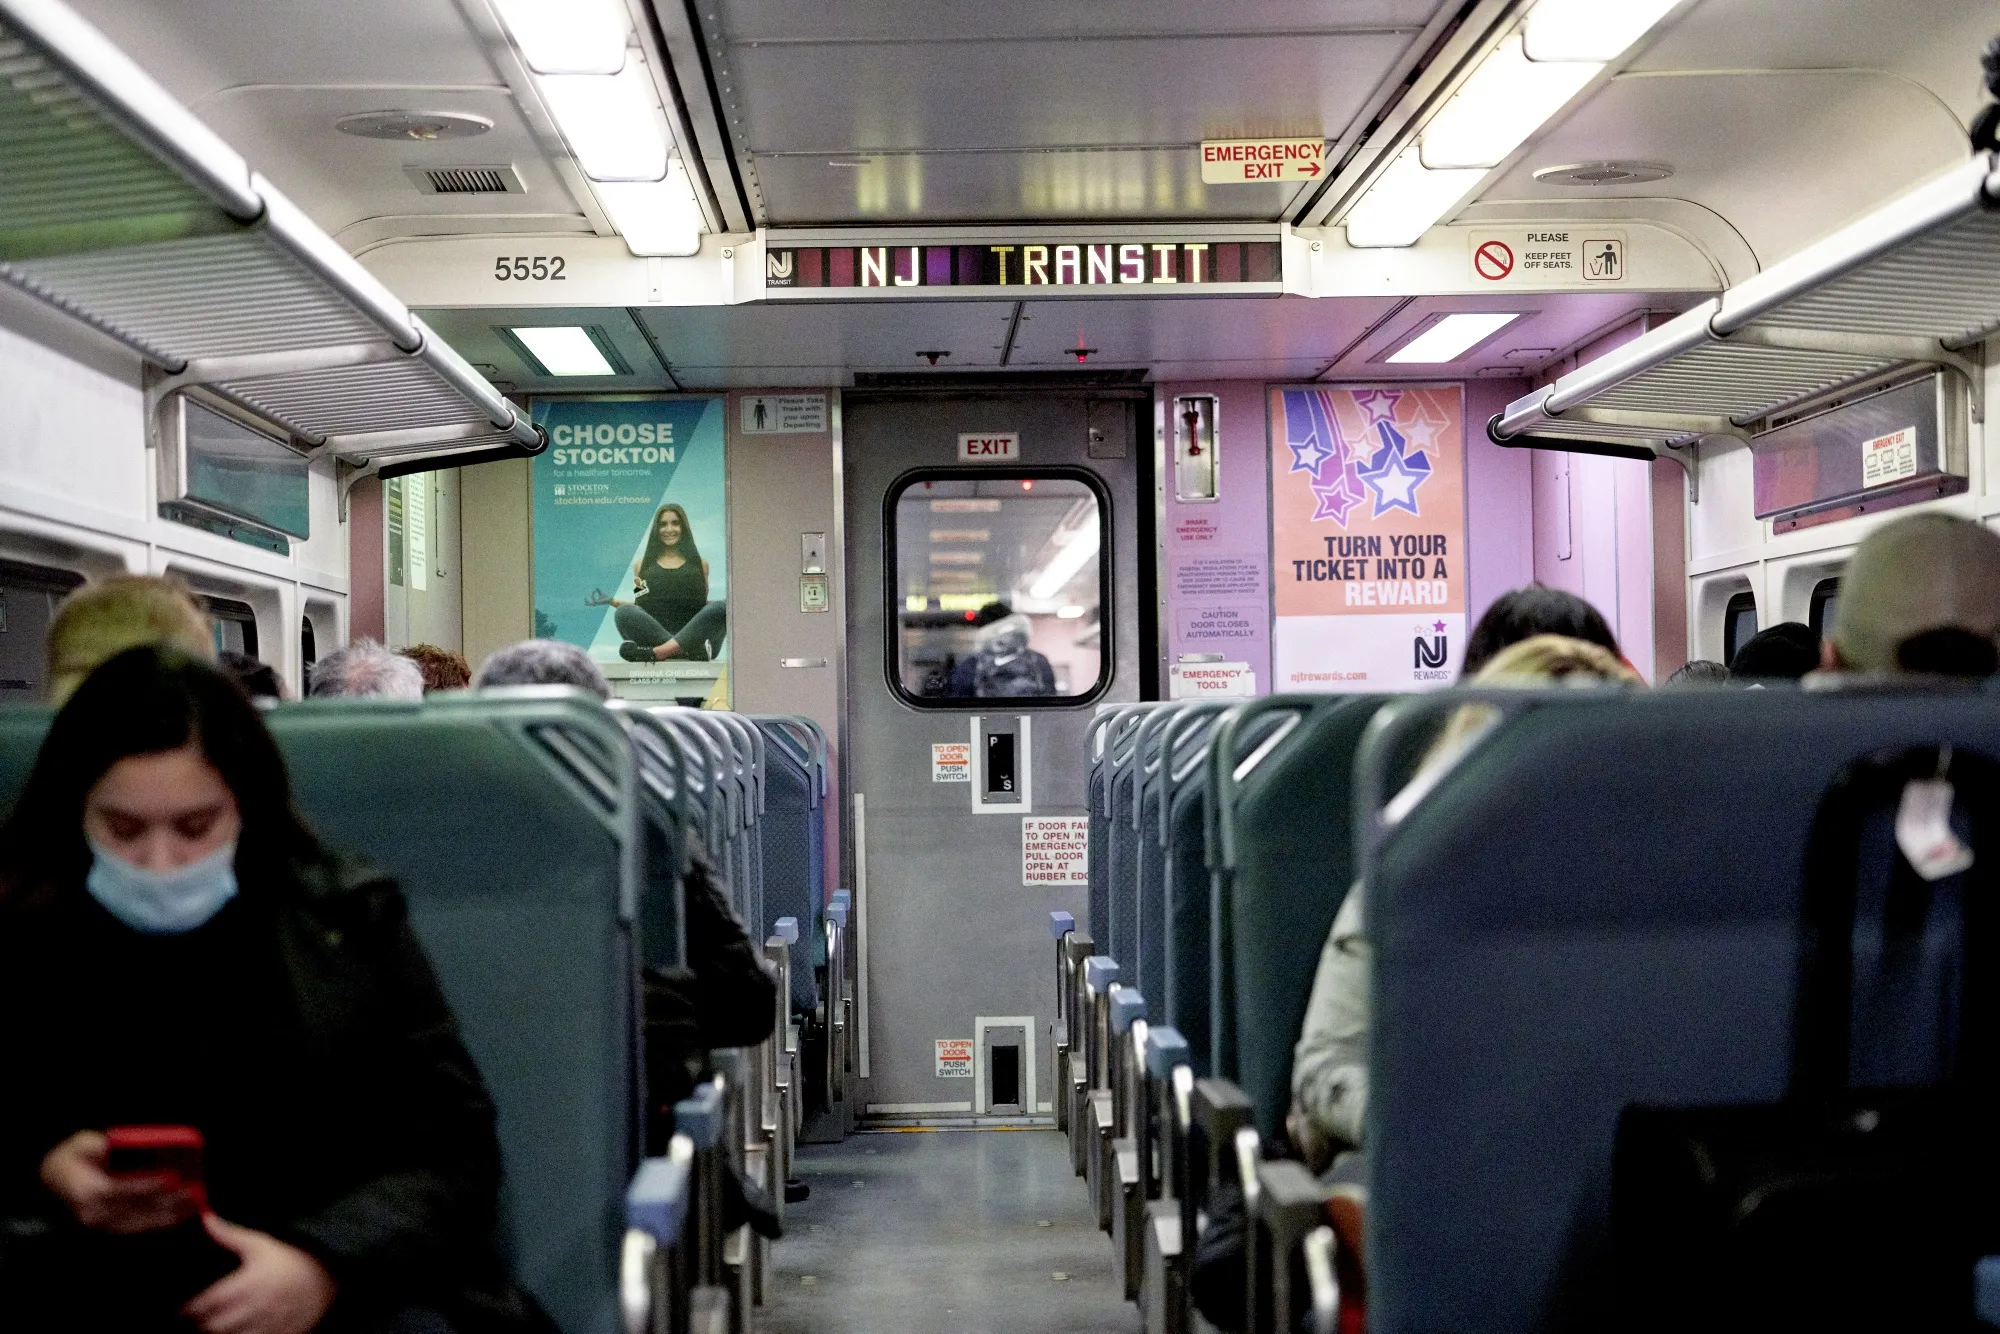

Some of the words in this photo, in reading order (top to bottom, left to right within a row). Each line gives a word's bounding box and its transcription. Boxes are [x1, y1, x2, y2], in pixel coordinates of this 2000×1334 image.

[1204, 144, 1323, 162] EMERGENCY
[1244, 163, 1284, 178] EXIT
[1527, 233, 1569, 242] PLEASE
[1525, 252, 1548, 260] KEEP
[1550, 252, 1571, 260] FEET
[494, 256, 566, 281] 5552
[861, 247, 919, 287] NJ
[991, 244, 1208, 285] TRANSIT
[1524, 261, 1541, 269] OFF
[1543, 261, 1573, 269] SEATS.
[552, 423, 674, 445] CHOOSE
[967, 439, 1011, 455] EXIT
[552, 447, 675, 465] STOCKTON
[553, 469, 564, 477] for
[554, 496, 651, 505] stockton.edu/choose
[1324, 535, 1381, 557] TURN
[1389, 534, 1447, 556] YOUR
[1292, 559, 1368, 581] TICKET
[1377, 558, 1425, 579] INTO
[1433, 558, 1448, 579] A
[1345, 581, 1448, 606] REWARD
[1201, 611, 1238, 619] CAUTION
[1217, 620, 1249, 628] CLOSES
[1186, 630, 1255, 638] AUTOMATICALLY
[1414, 635, 1447, 669] NJ
[1182, 670, 1241, 679] EMERGENCY
[1291, 671, 1367, 683] njtrewards.com
[1413, 670, 1448, 680] REWARDS
[1196, 681, 1228, 689] TOOLS
[990, 736, 998, 747] P
[936, 773, 968, 781] SWITCH
[1003, 779, 1012, 790] S
[1025, 822, 1034, 830] IF
[1038, 822, 1067, 830] DOOR
[1025, 832, 1038, 840] TO
[1042, 832, 1070, 840] OPEN
[1075, 832, 1085, 840] IN
[1025, 842, 1087, 850] EMERGENCY
[1025, 852, 1050, 860] PULL
[1055, 852, 1083, 860] DOOR
[1057, 862, 1069, 870] AT
